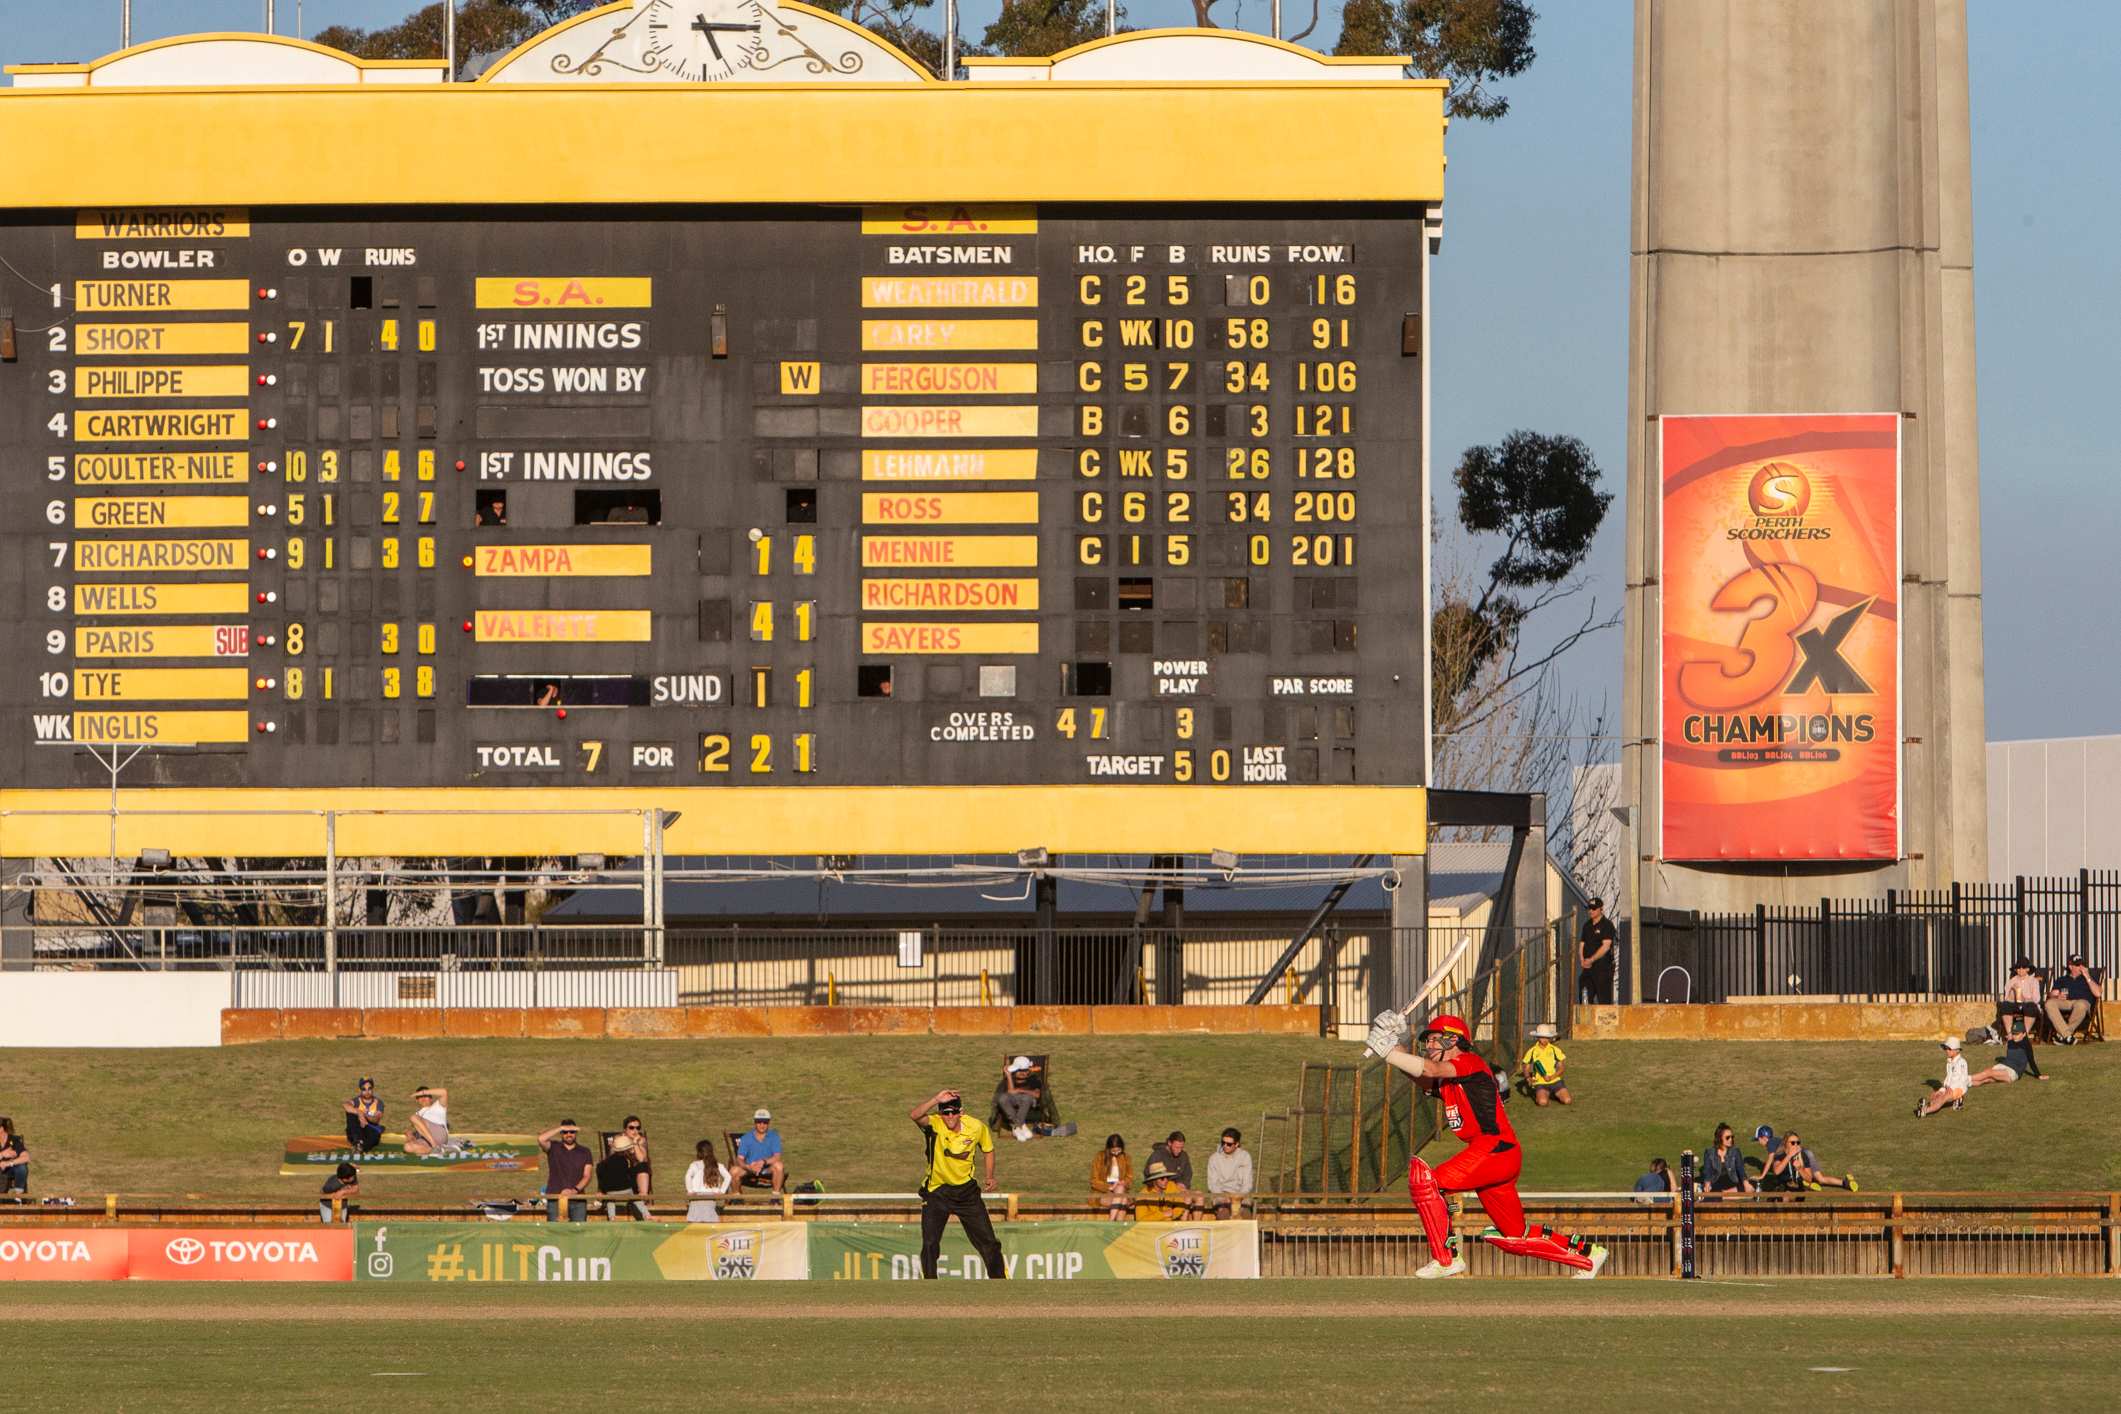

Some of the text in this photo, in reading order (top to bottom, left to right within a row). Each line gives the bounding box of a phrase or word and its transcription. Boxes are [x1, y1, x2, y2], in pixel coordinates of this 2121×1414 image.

[101, 209, 225, 237] WARRIORS
[902, 206, 988, 232] S.A.
[103, 250, 214, 269] BOWLER
[288, 248, 416, 266] O W RUNS
[888, 246, 1011, 264] BATSMEN
[1131, 246, 1146, 263] F
[1169, 246, 1186, 263] B
[1212, 246, 1271, 263] RUNS
[50, 283, 171, 308] 1 TURNER
[513, 281, 604, 306] S.A.
[1080, 275, 1101, 305] C
[1126, 275, 1146, 305] 2
[1168, 275, 1189, 305] 5
[48, 326, 67, 352] 2
[86, 328, 165, 351] SHORT
[288, 321, 305, 350] 7
[514, 323, 641, 349] INNINGS
[871, 323, 957, 346] CAREY
[1082, 320, 1103, 348] C
[1120, 320, 1153, 346] WK
[1166, 319, 1194, 349] 10
[1228, 318, 1269, 349] 58
[48, 369, 183, 394] 3 PHILIPPE
[479, 367, 646, 392] TOSS WON BY
[788, 366, 812, 389] W
[871, 367, 998, 391] FERGUSON
[1079, 362, 1102, 392] C
[1124, 363, 1148, 392] 5
[1168, 363, 1189, 390] 7
[1226, 361, 1270, 393] 34
[48, 413, 235, 438] 4 CARTWRIGHT
[866, 410, 963, 433] COOPER
[1082, 405, 1103, 436] B
[1168, 405, 1190, 436] 6
[1251, 405, 1268, 437] 3
[48, 456, 66, 481] 5
[77, 456, 234, 480] COULTER-NILE
[322, 451, 338, 481] 3
[523, 452, 651, 480] INNINGS
[1080, 448, 1100, 477] C
[1119, 450, 1153, 478] WK
[1166, 449, 1188, 479] 5
[1229, 447, 1270, 480] 26
[46, 500, 65, 524] 6
[92, 502, 165, 525] GREEN
[289, 495, 304, 525] 5
[879, 498, 942, 520] ROSS
[1081, 492, 1356, 523] C 6 2 34 200
[1726, 528, 1831, 540] SCORCHERS
[1755, 517, 1803, 527] PERTH
[49, 543, 68, 568] 7
[81, 543, 234, 567] RICHARDSON
[287, 538, 304, 569] 9
[485, 547, 573, 573] ZAMPA
[868, 541, 954, 563] MENNIE
[1080, 537, 1102, 565] C
[1168, 535, 1190, 565] 5
[47, 586, 157, 611] 8 WELLS
[868, 583, 1018, 606] RICHARDSON
[46, 629, 66, 654] 9
[85, 631, 155, 653] PARIS
[216, 628, 248, 656] SUB
[287, 623, 304, 655] 8
[871, 627, 961, 650] SAYERS
[1153, 661, 1208, 676] POWER
[39, 672, 69, 697] 10
[82, 673, 122, 697] TYE
[653, 675, 721, 703] SUND
[1159, 679, 1199, 694] PLAY
[1273, 679, 1353, 695] PAR SCORE
[33, 714, 158, 740] WK INGLIS
[950, 712, 1013, 726] OVERS
[1176, 707, 1194, 739] 3
[1683, 714, 1875, 745] CHAMPIONS
[931, 725, 1034, 741] COMPLETED
[477, 746, 560, 767] TOTAL
[582, 742, 602, 772] 7
[633, 746, 674, 767] FOR
[1087, 756, 1164, 775] TARGET
[1243, 747, 1285, 764] LAST
[1243, 765, 1287, 781] HOUR
[210, 1241, 319, 1262] TOYOTA
[1180, 1238, 1202, 1251] JLT
[719, 1256, 752, 1266] ONE
[1026, 1252, 1082, 1279] CUP
[1168, 1255, 1203, 1264] ONE
[1169, 1264, 1202, 1278] DAY
[719, 1266, 752, 1280] DAY
